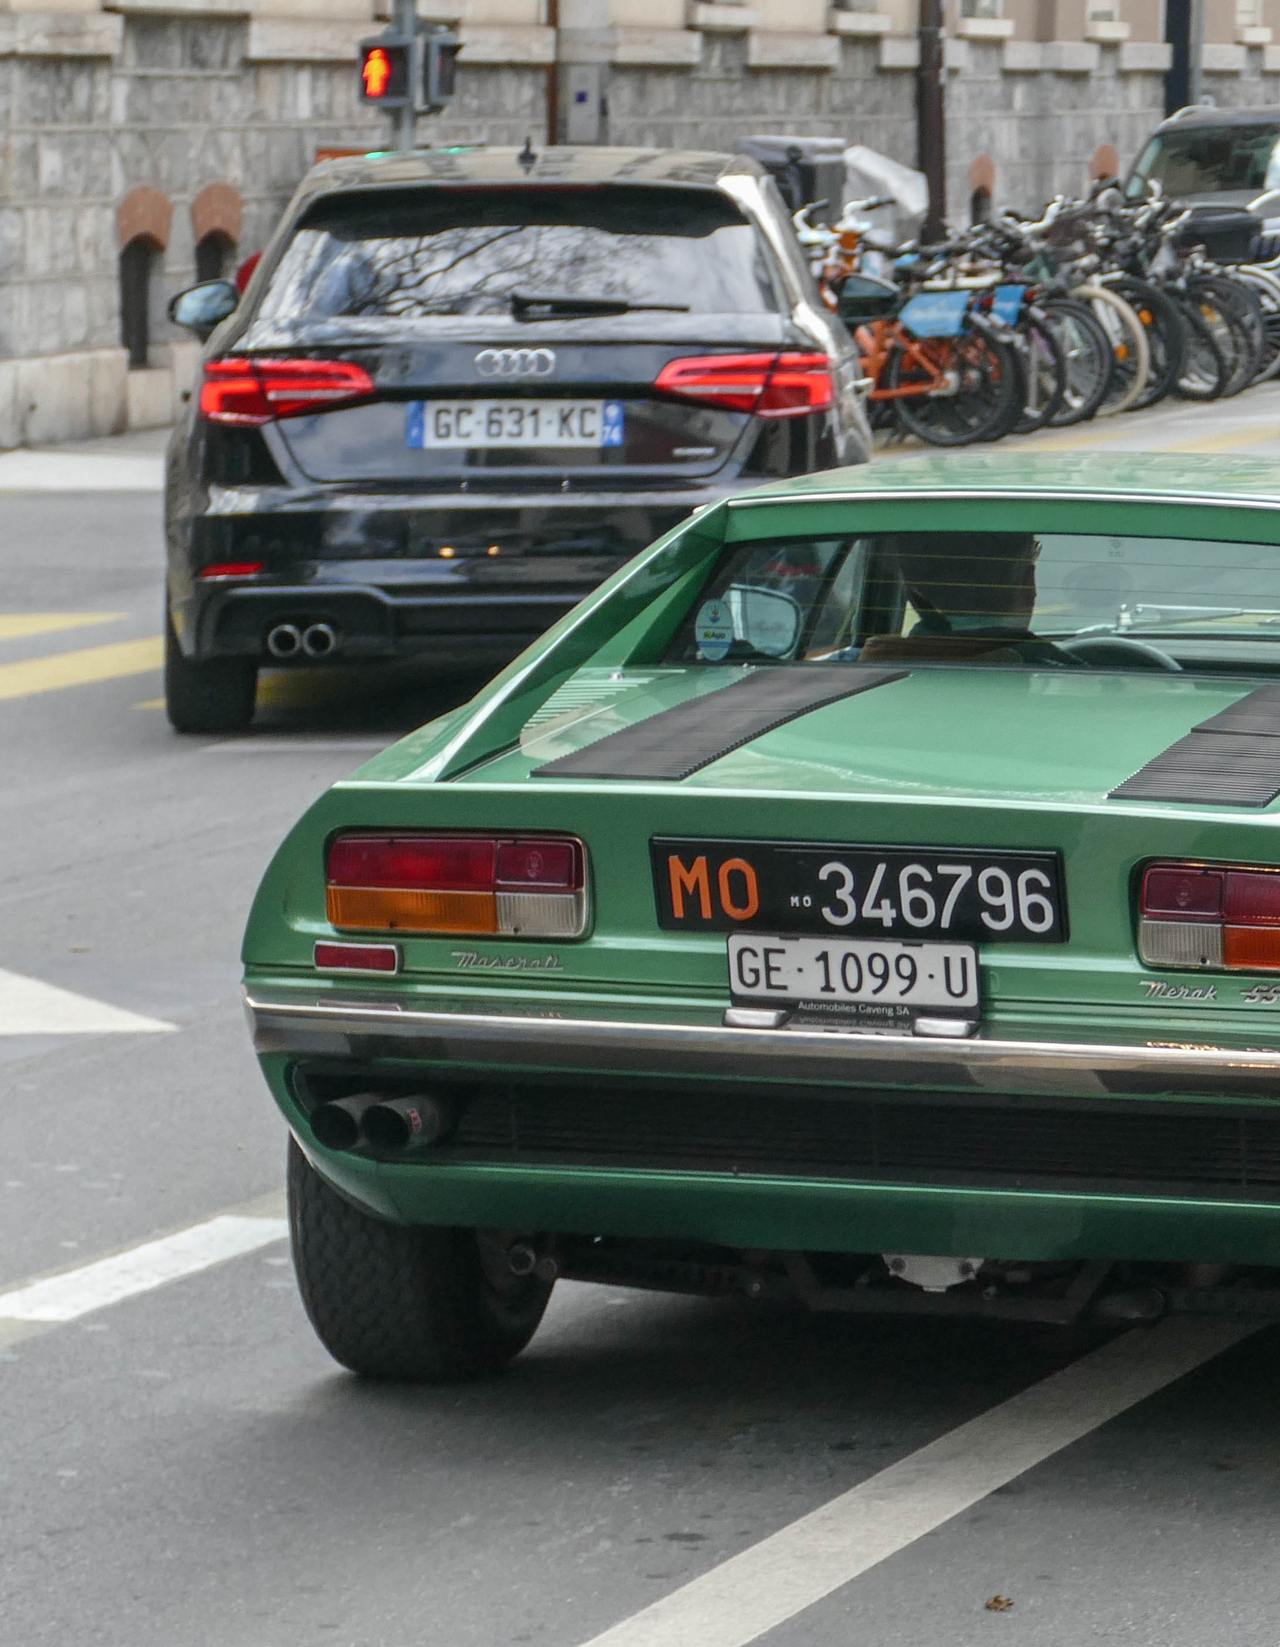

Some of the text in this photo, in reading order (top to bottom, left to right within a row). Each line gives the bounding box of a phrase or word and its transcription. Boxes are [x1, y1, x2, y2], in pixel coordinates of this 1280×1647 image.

[668, 854, 1055, 933] MO MO 346796
[1139, 980, 1217, 1000] Merak
[798, 1001, 910, 1017] Automobiles Caveng SA
